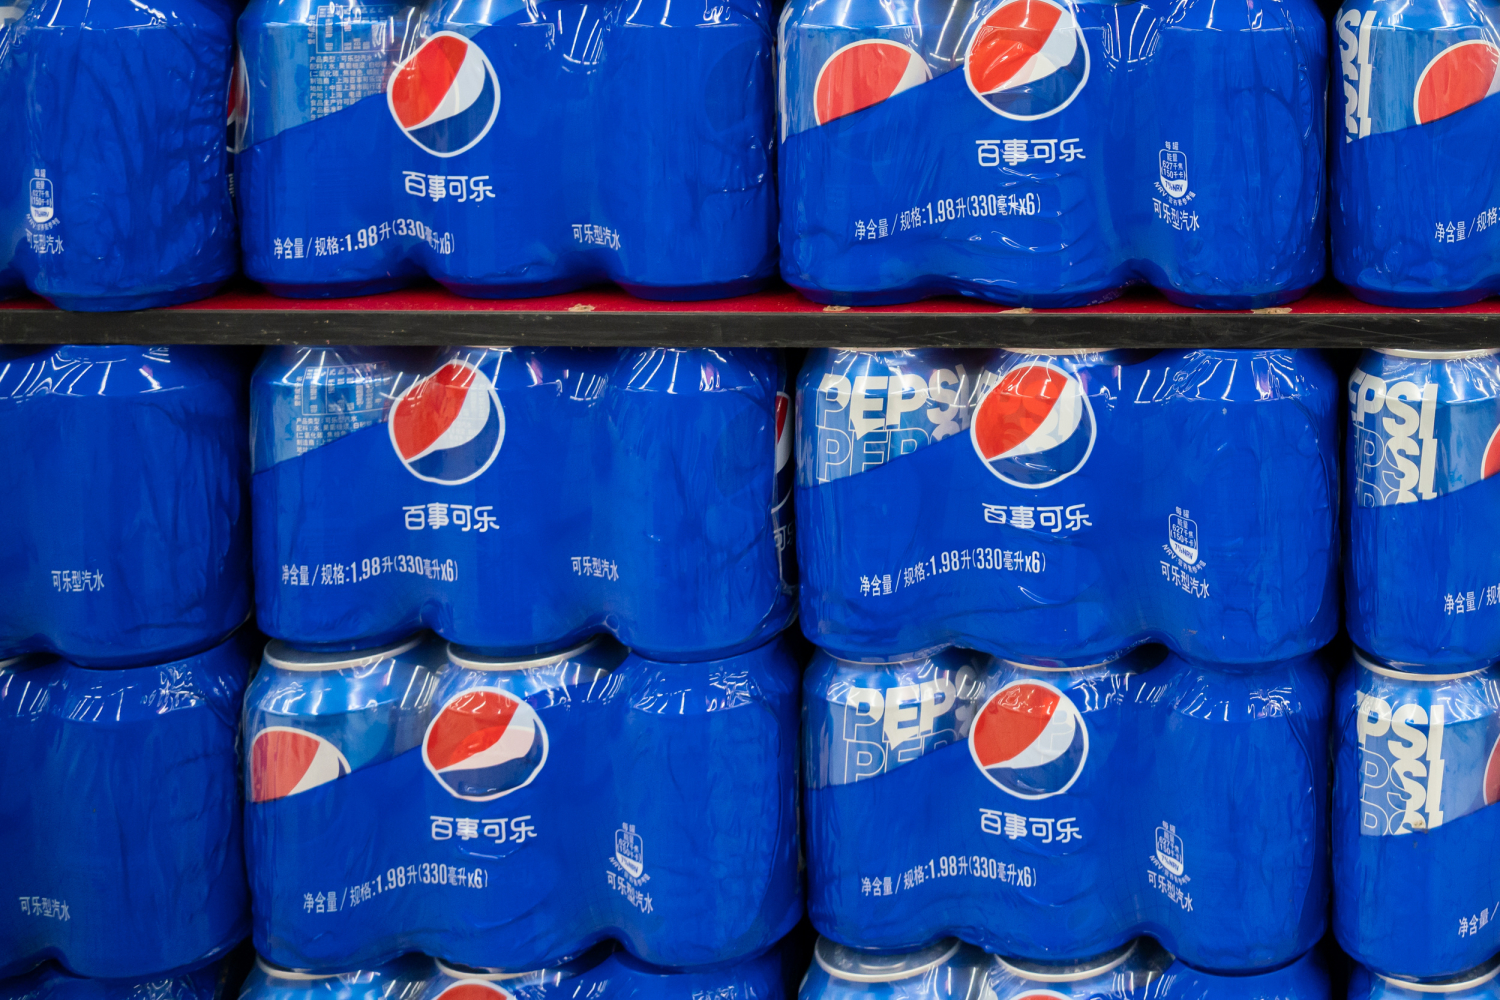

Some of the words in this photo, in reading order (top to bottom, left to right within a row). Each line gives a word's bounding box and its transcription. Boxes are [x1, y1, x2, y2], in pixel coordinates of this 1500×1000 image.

[975, 138, 1086, 167] 百事可乐
[402, 170, 495, 202] 百事可乐
[1153, 198, 1200, 230] 可乐型汽水
[572, 223, 621, 250] 可乐型汽水
[402, 502, 499, 532] 百事可乐
[982, 503, 1092, 532] 百事可乐
[51, 569, 104, 592] 可乐型汽水
[571, 555, 619, 581] 可乐型汽水
[1160, 561, 1209, 598] 可乐型汽水
[430, 816, 537, 843] 百事可乐
[979, 808, 1082, 841] 百事可乐
[1147, 868, 1193, 912] 可乐型汽水
